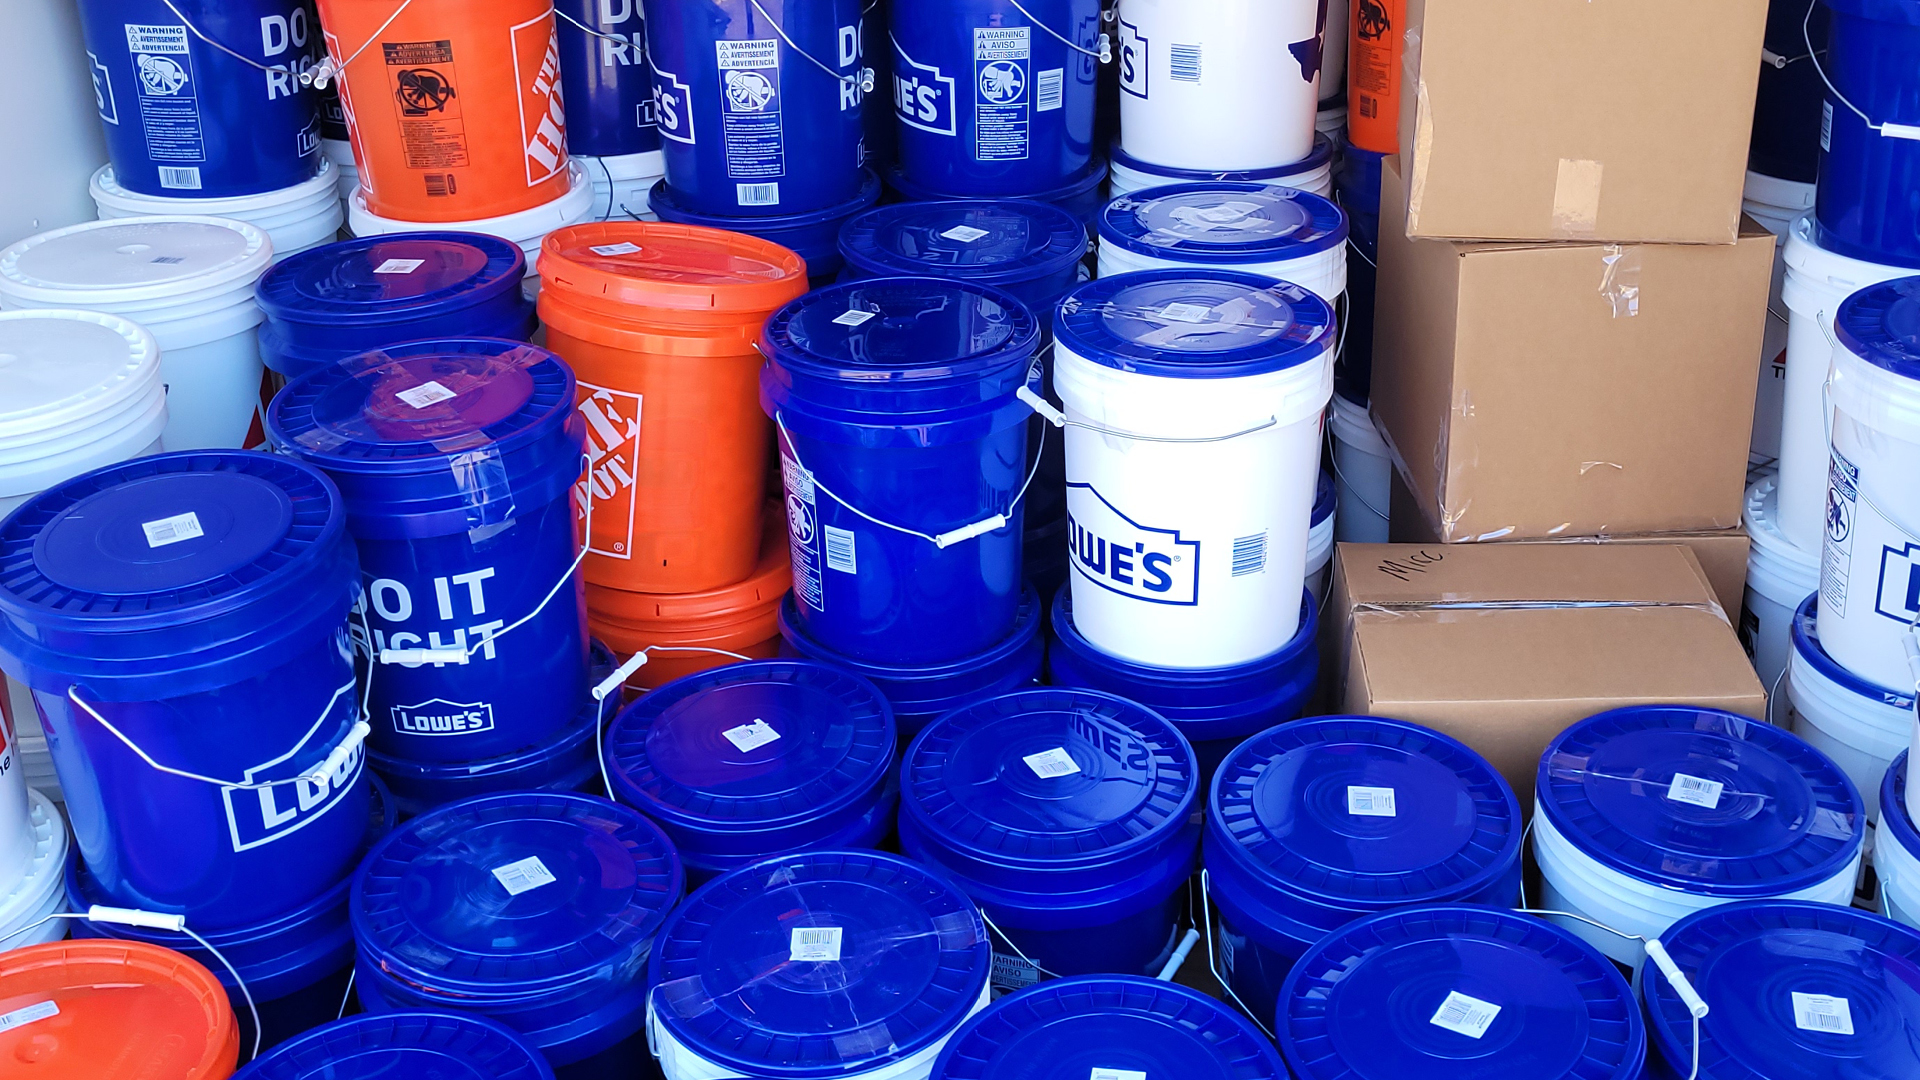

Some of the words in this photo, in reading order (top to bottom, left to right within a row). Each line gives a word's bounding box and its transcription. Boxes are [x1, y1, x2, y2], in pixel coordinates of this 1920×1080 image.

[138, 26, 183, 34] WARNING
[986, 30, 1025, 39] WARNING
[141, 44, 186, 52] ADVERTENCIA
[402, 42, 437, 50] WARNING
[730, 41, 775, 50] WARNING
[991, 40, 1015, 49] AVISO
[398, 48, 446, 58] ADVERTENCIA
[730, 50, 775, 59] AVERTISSEMENT
[986, 50, 1028, 59] AVERTISSEMENT
[731, 59, 775, 67] ADVERTENCIA
[434, 567, 495, 621] IT
[401, 710, 484, 732] LOWE'S
[992, 954, 1033, 969] ARNING
[993, 964, 1022, 977] AVISO
